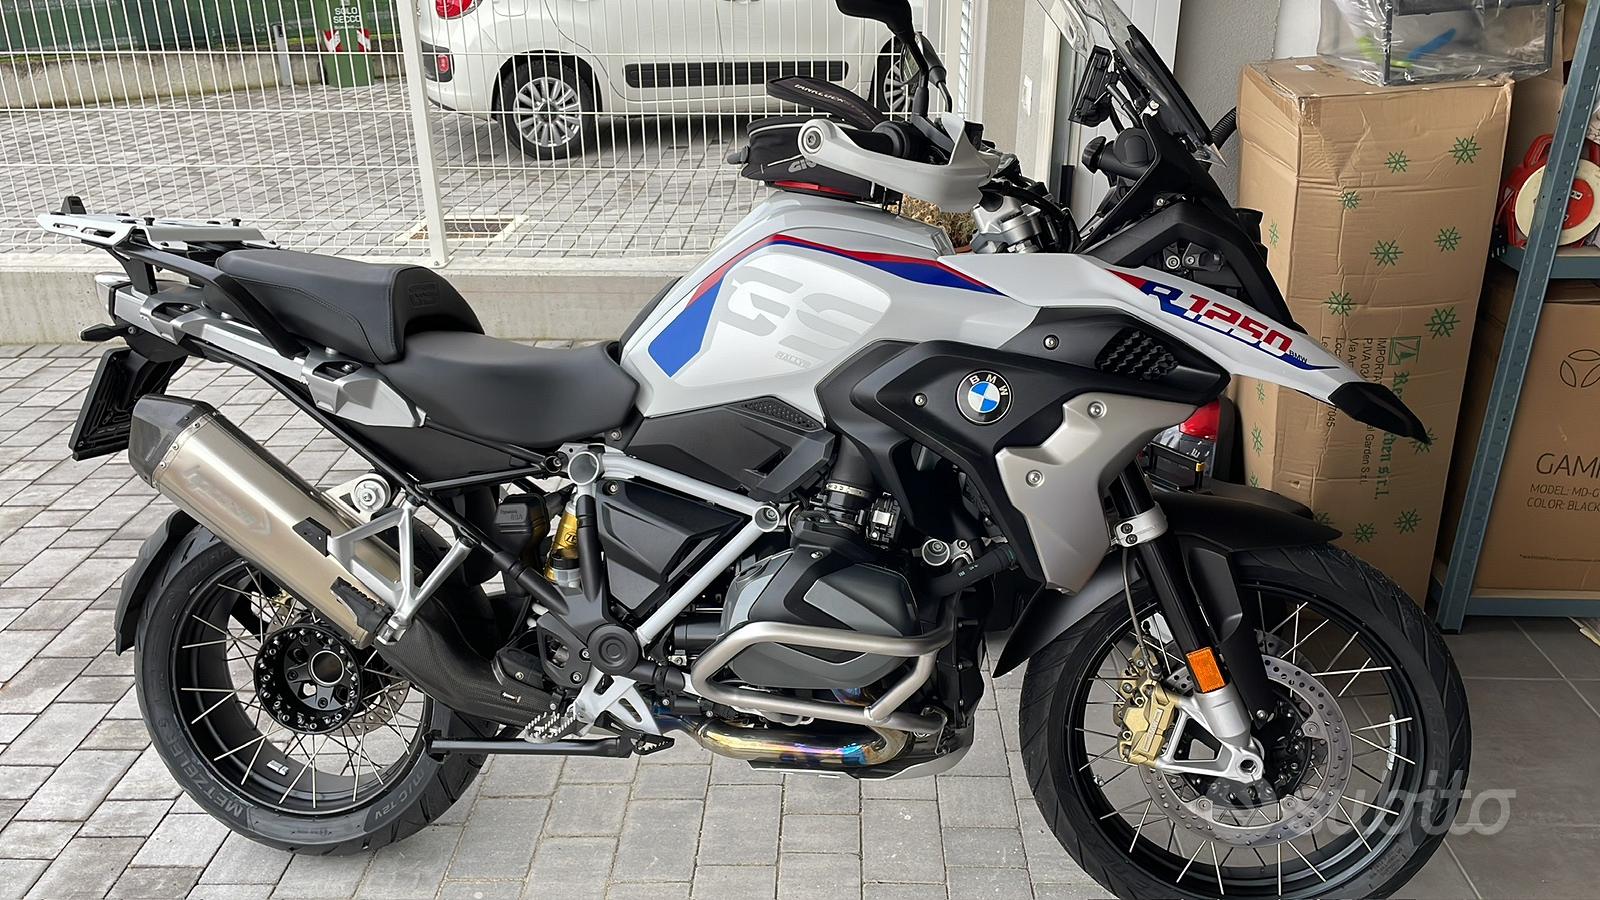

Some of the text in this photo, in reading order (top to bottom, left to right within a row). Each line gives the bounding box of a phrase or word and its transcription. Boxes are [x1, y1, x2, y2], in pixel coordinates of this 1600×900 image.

[333, 15, 361, 24] SECCO
[334, 7, 358, 15] SOLO
[1184, 293, 1293, 358] 1250
[1374, 337, 1387, 385] IMPORTA
[969, 373, 1009, 396] BMW
[1536, 452, 1600, 479] GAM
[1529, 483, 1568, 496] MODEL:
[1526, 497, 1564, 510] COLOR:
